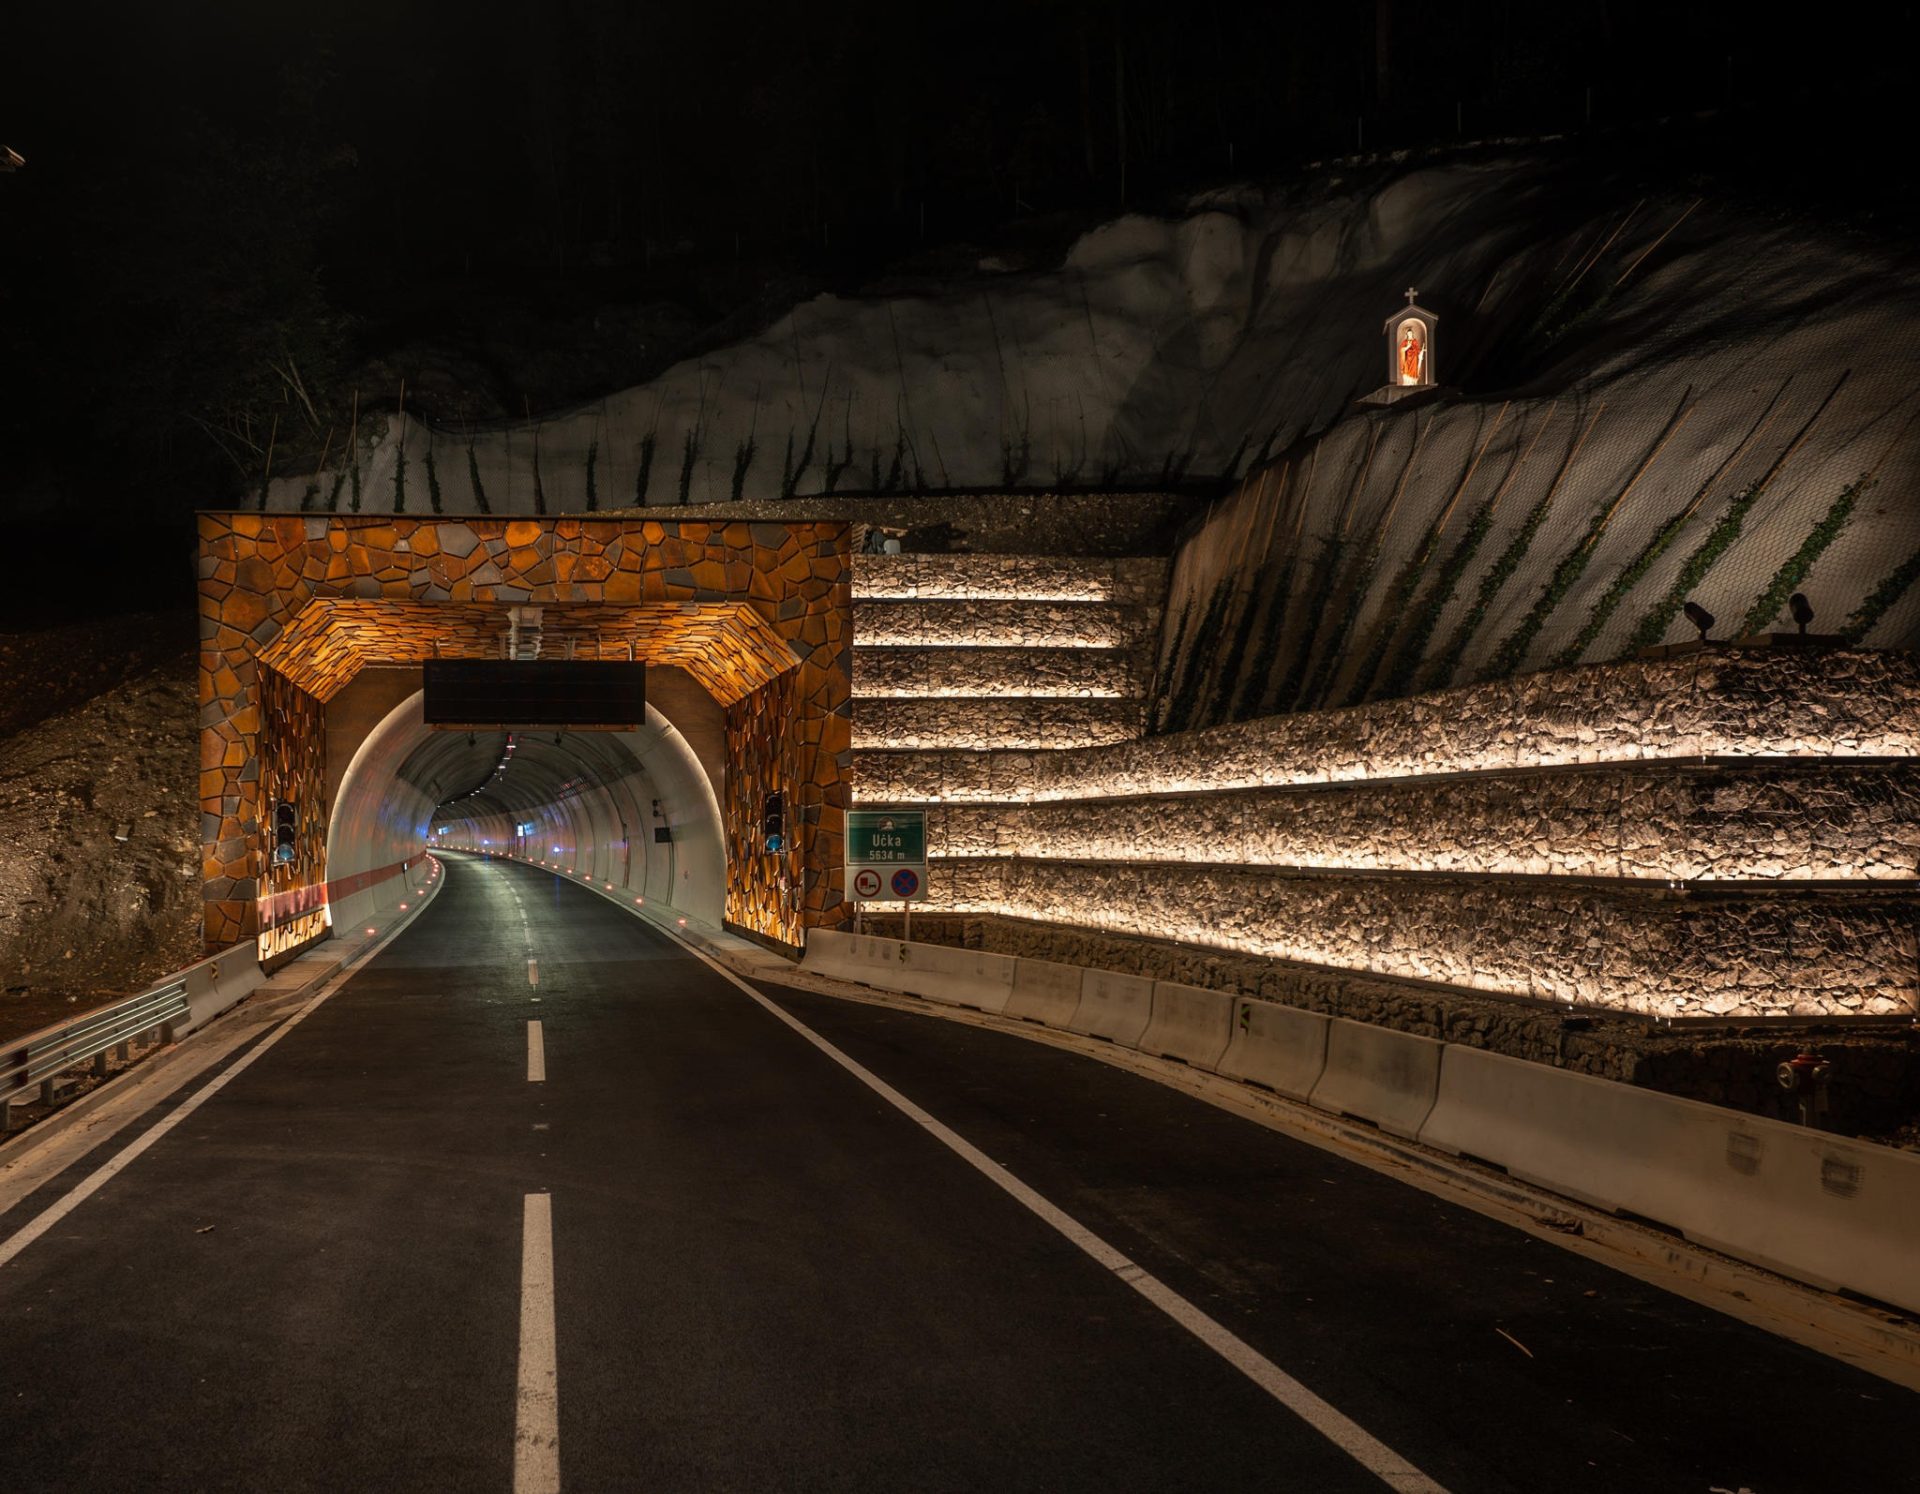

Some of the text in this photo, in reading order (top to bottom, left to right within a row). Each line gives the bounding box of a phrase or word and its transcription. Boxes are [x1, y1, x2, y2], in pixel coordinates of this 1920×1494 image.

[872, 833, 901, 847] Učka
[869, 850, 905, 860] 5634 m
